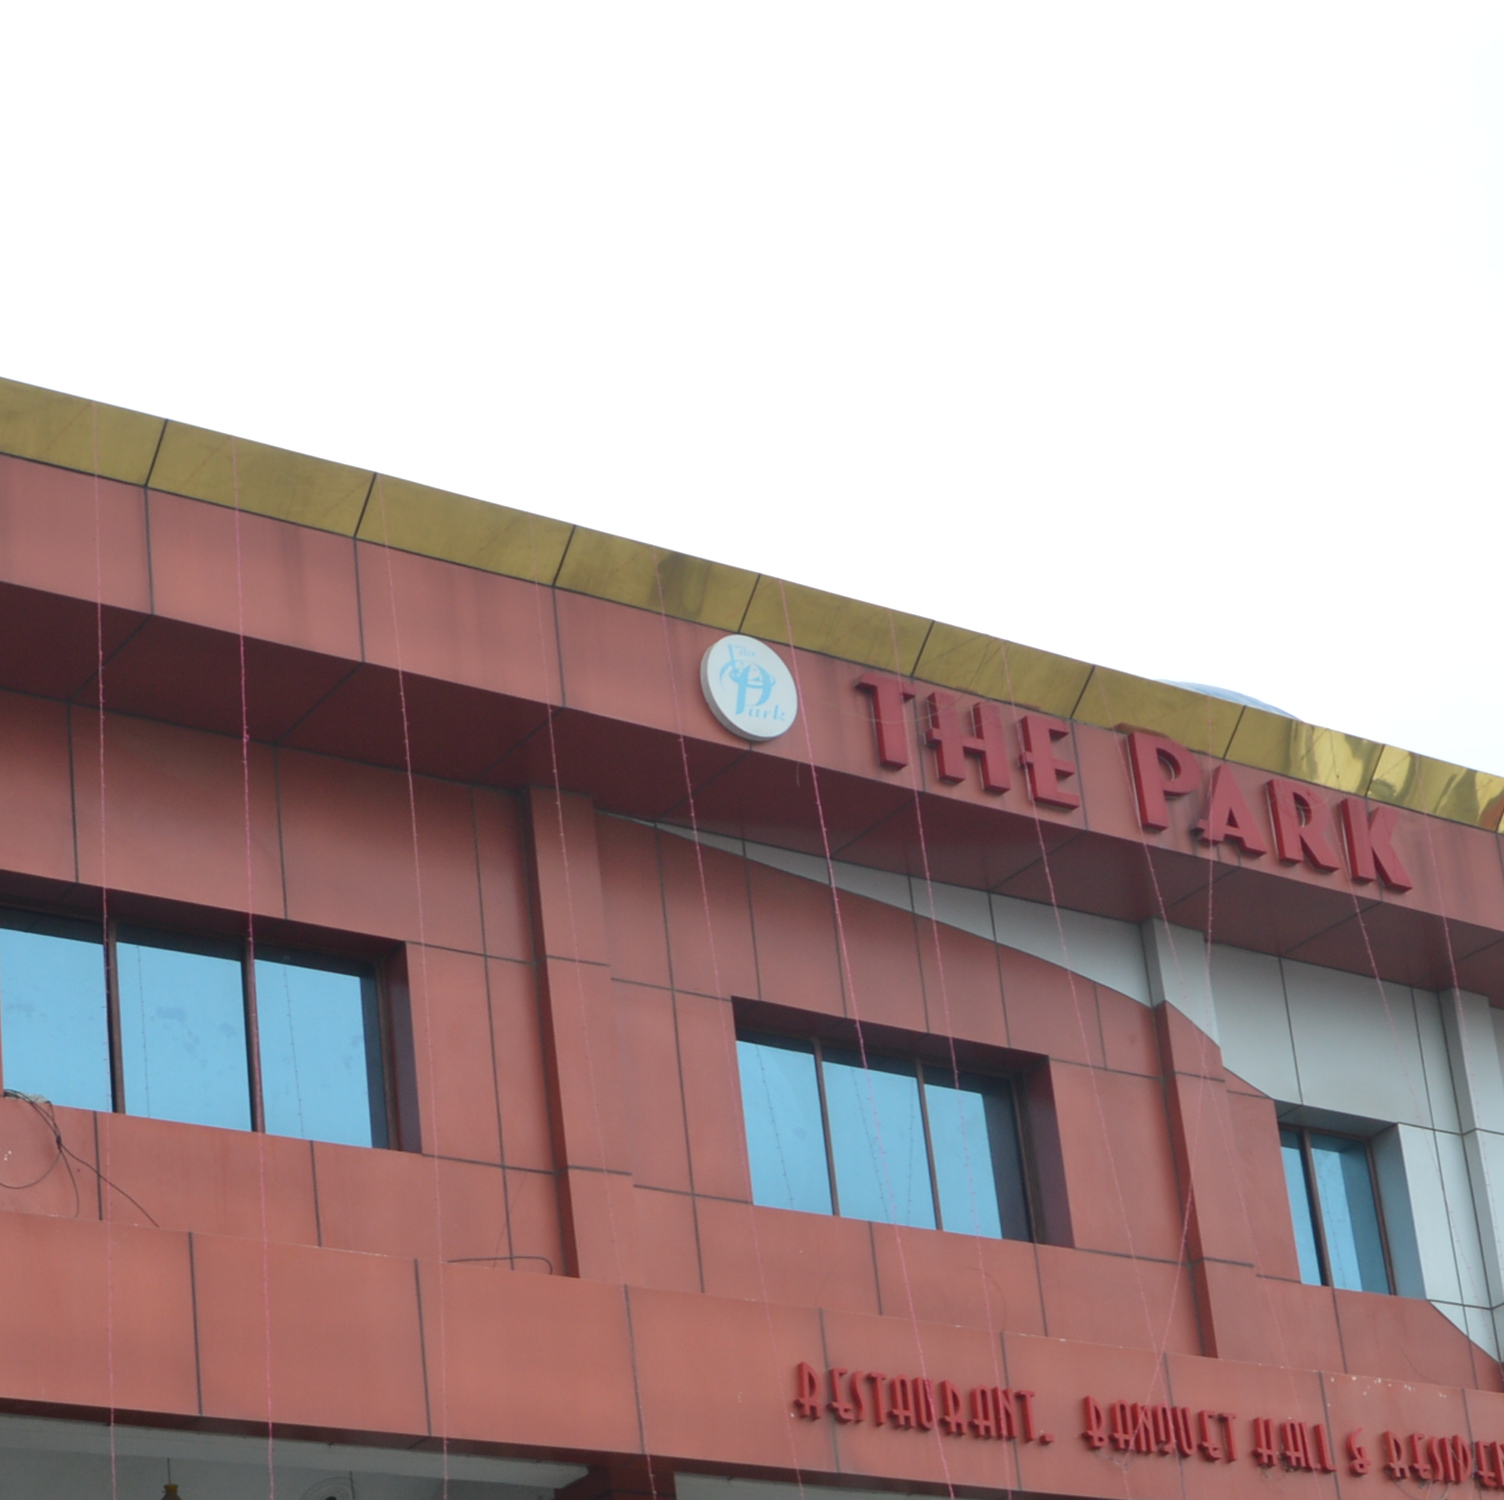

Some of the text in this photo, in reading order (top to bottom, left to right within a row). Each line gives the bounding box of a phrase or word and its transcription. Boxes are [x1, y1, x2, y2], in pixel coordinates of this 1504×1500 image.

[856, 676, 1412, 892] THE PARK
[1080, 1396, 1237, 1463] BANQUET
[1252, 1417, 1337, 1474] HALL
[1347, 1427, 1371, 1475] &
